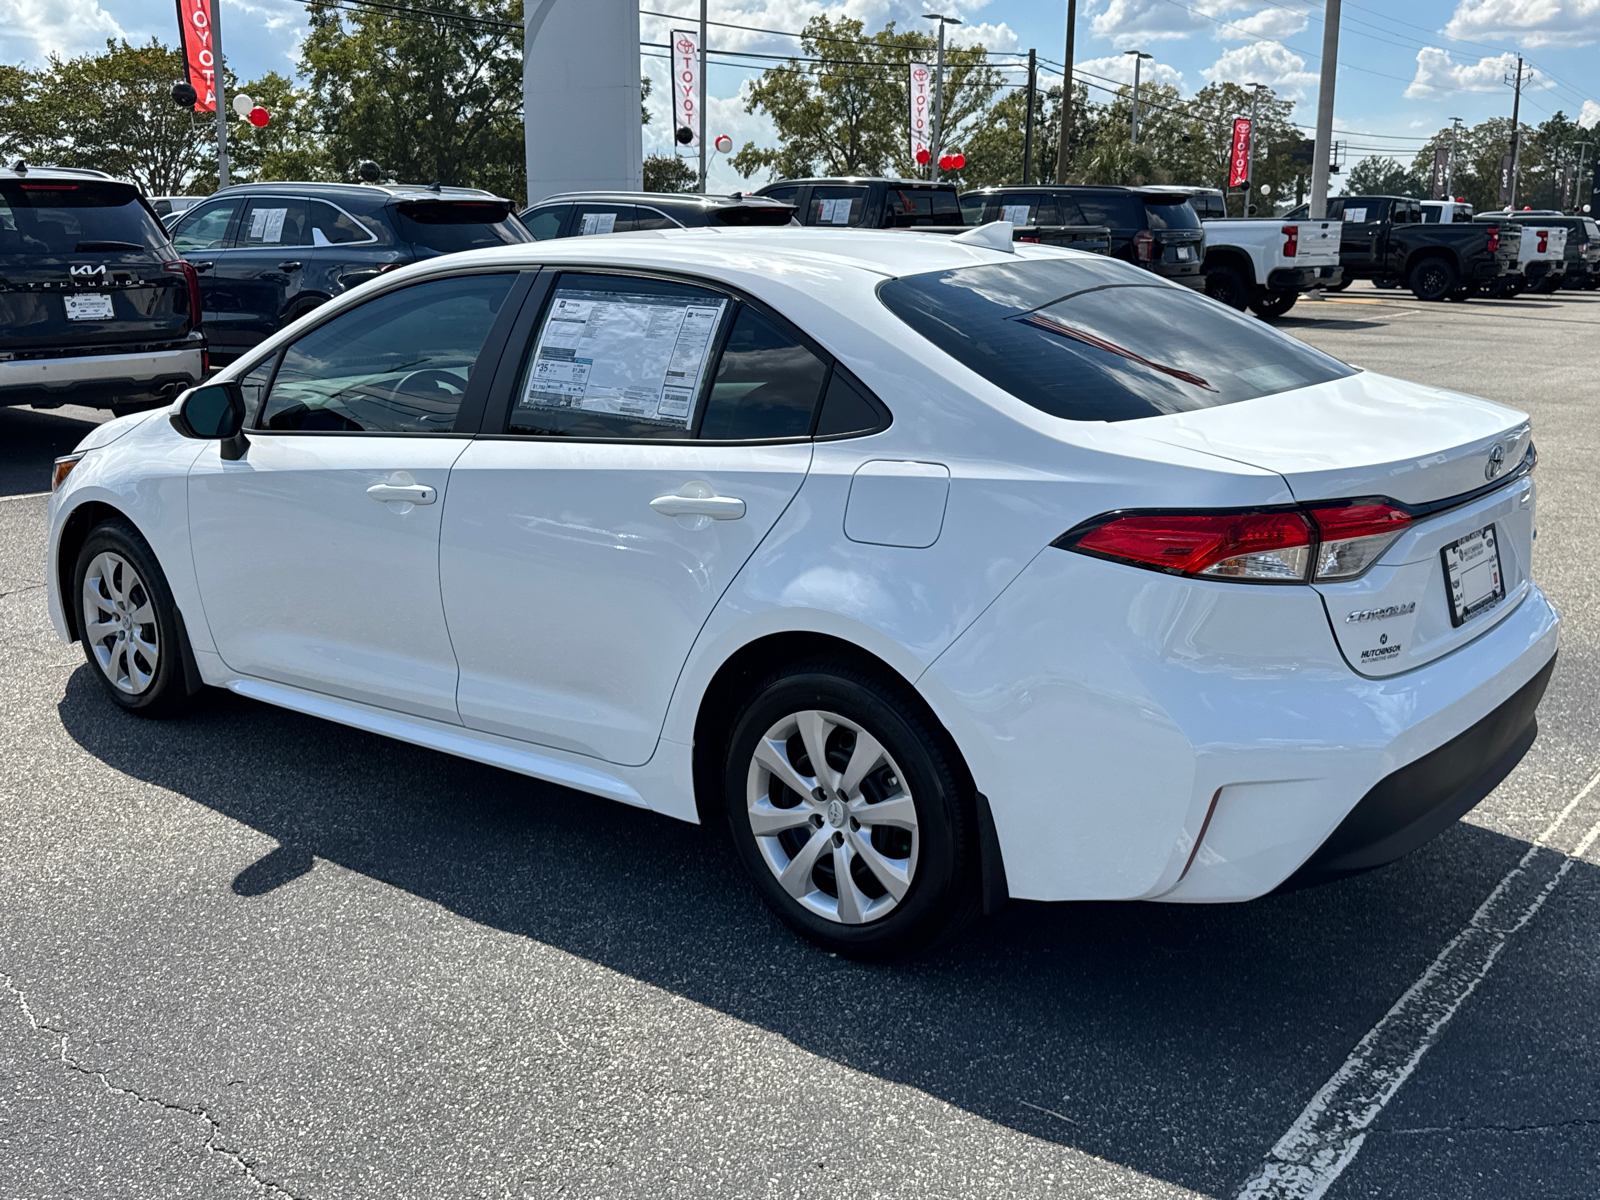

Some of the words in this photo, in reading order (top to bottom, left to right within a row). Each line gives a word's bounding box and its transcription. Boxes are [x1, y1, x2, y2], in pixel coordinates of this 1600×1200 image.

[682, 57, 694, 125] TOYOT
[1234, 134, 1246, 184] TOYOTA
[70, 265, 106, 275] KIA
[28, 280, 145, 288] TELLURIDE
[539, 363, 549, 372] 35
[1345, 601, 1416, 624] COROLLA
[1361, 644, 1402, 659] HUTCHINSON
[1361, 655, 1387, 664] AUTOMOTIVE
[1386, 652, 1400, 660] GROUP
